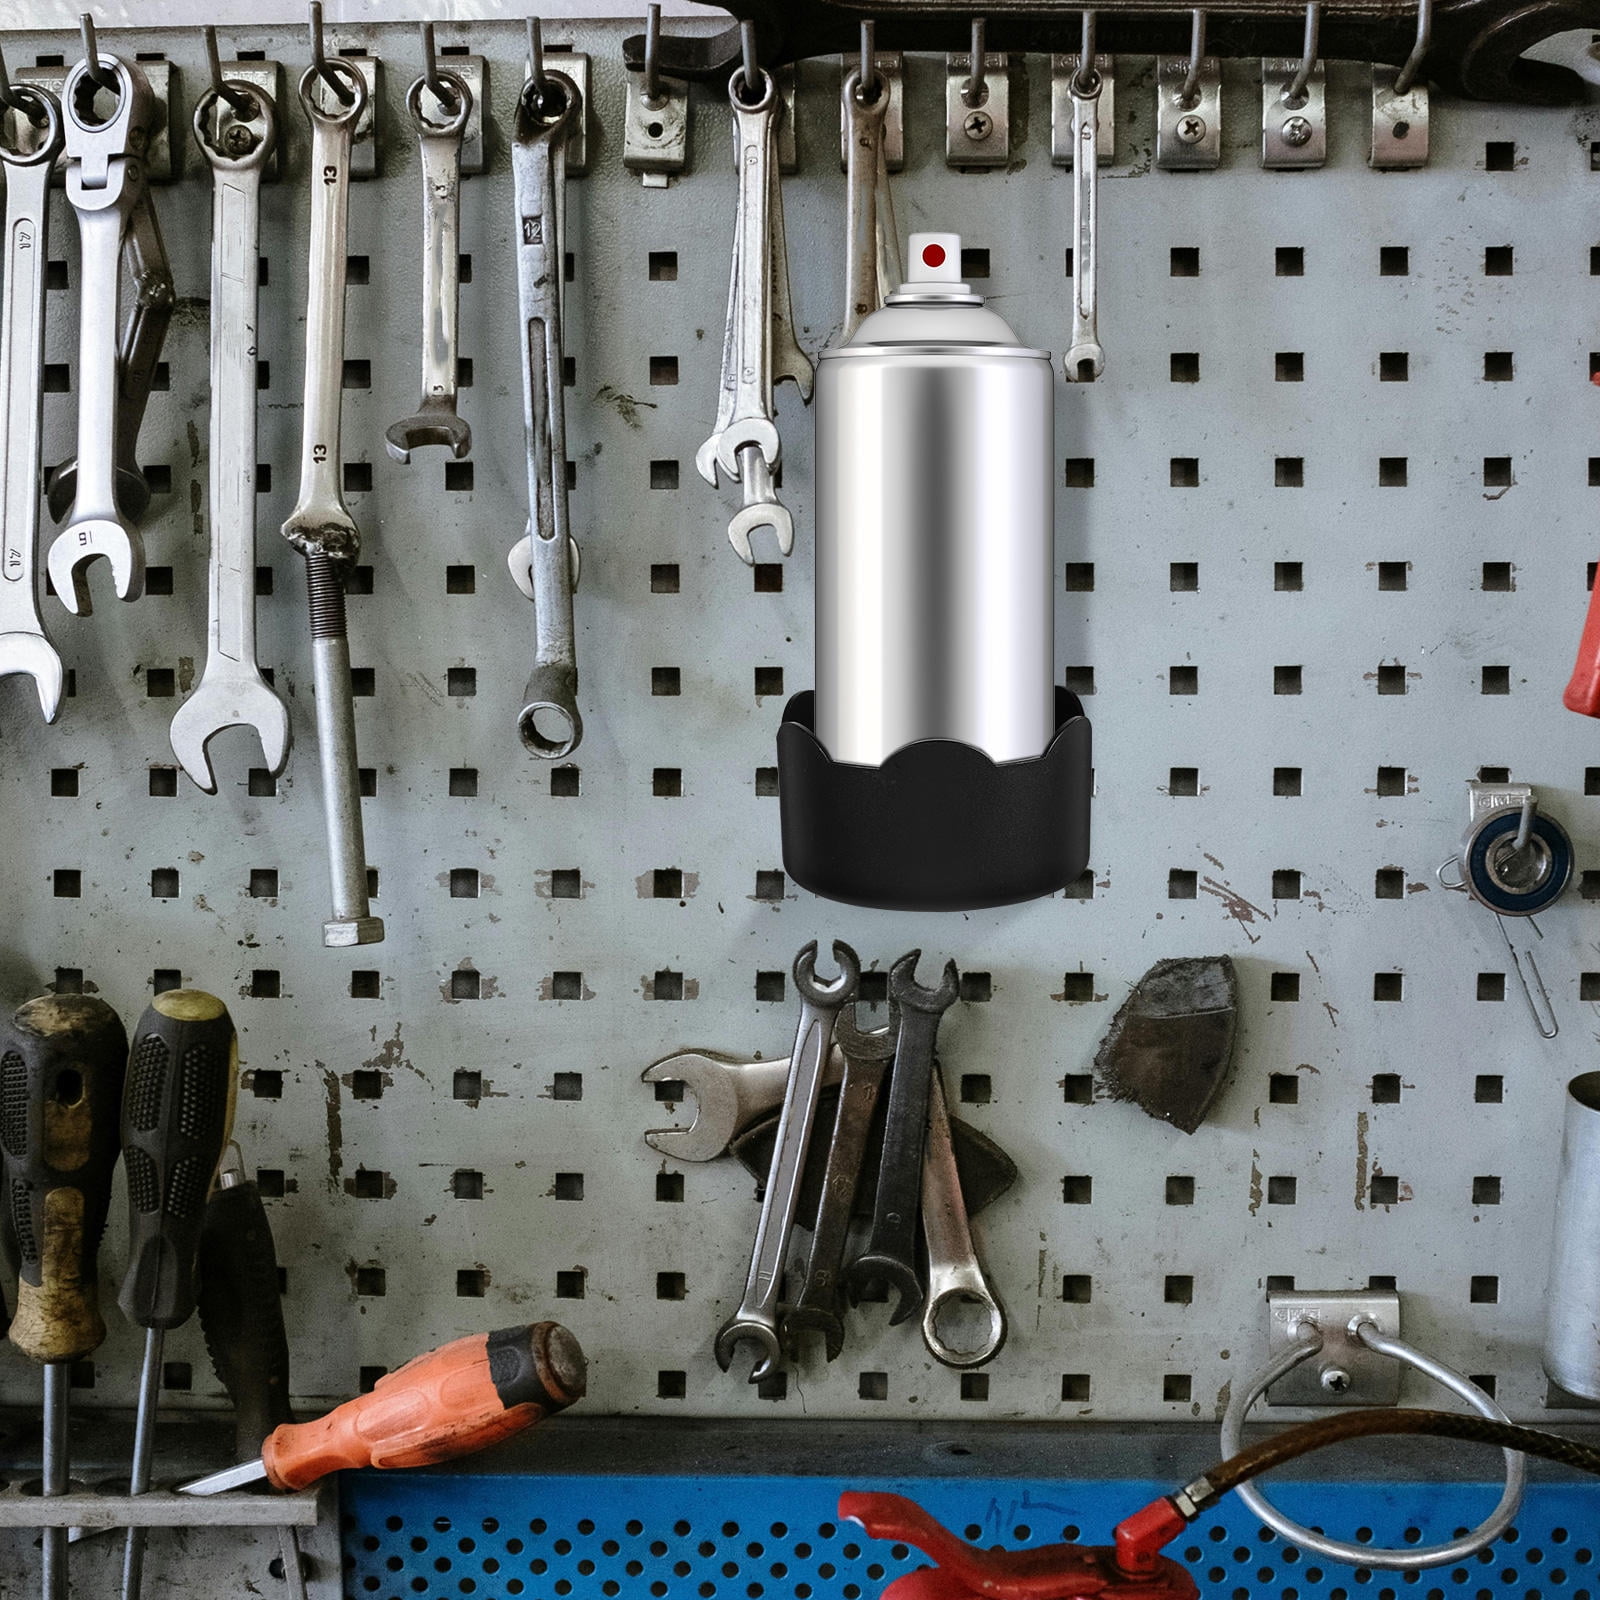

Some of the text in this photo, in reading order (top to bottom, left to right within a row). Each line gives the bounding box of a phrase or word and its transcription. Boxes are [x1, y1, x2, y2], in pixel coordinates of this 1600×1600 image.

[323, 165, 337, 186] 13
[524, 219, 542, 240] 12
[313, 444, 327, 465] 13
